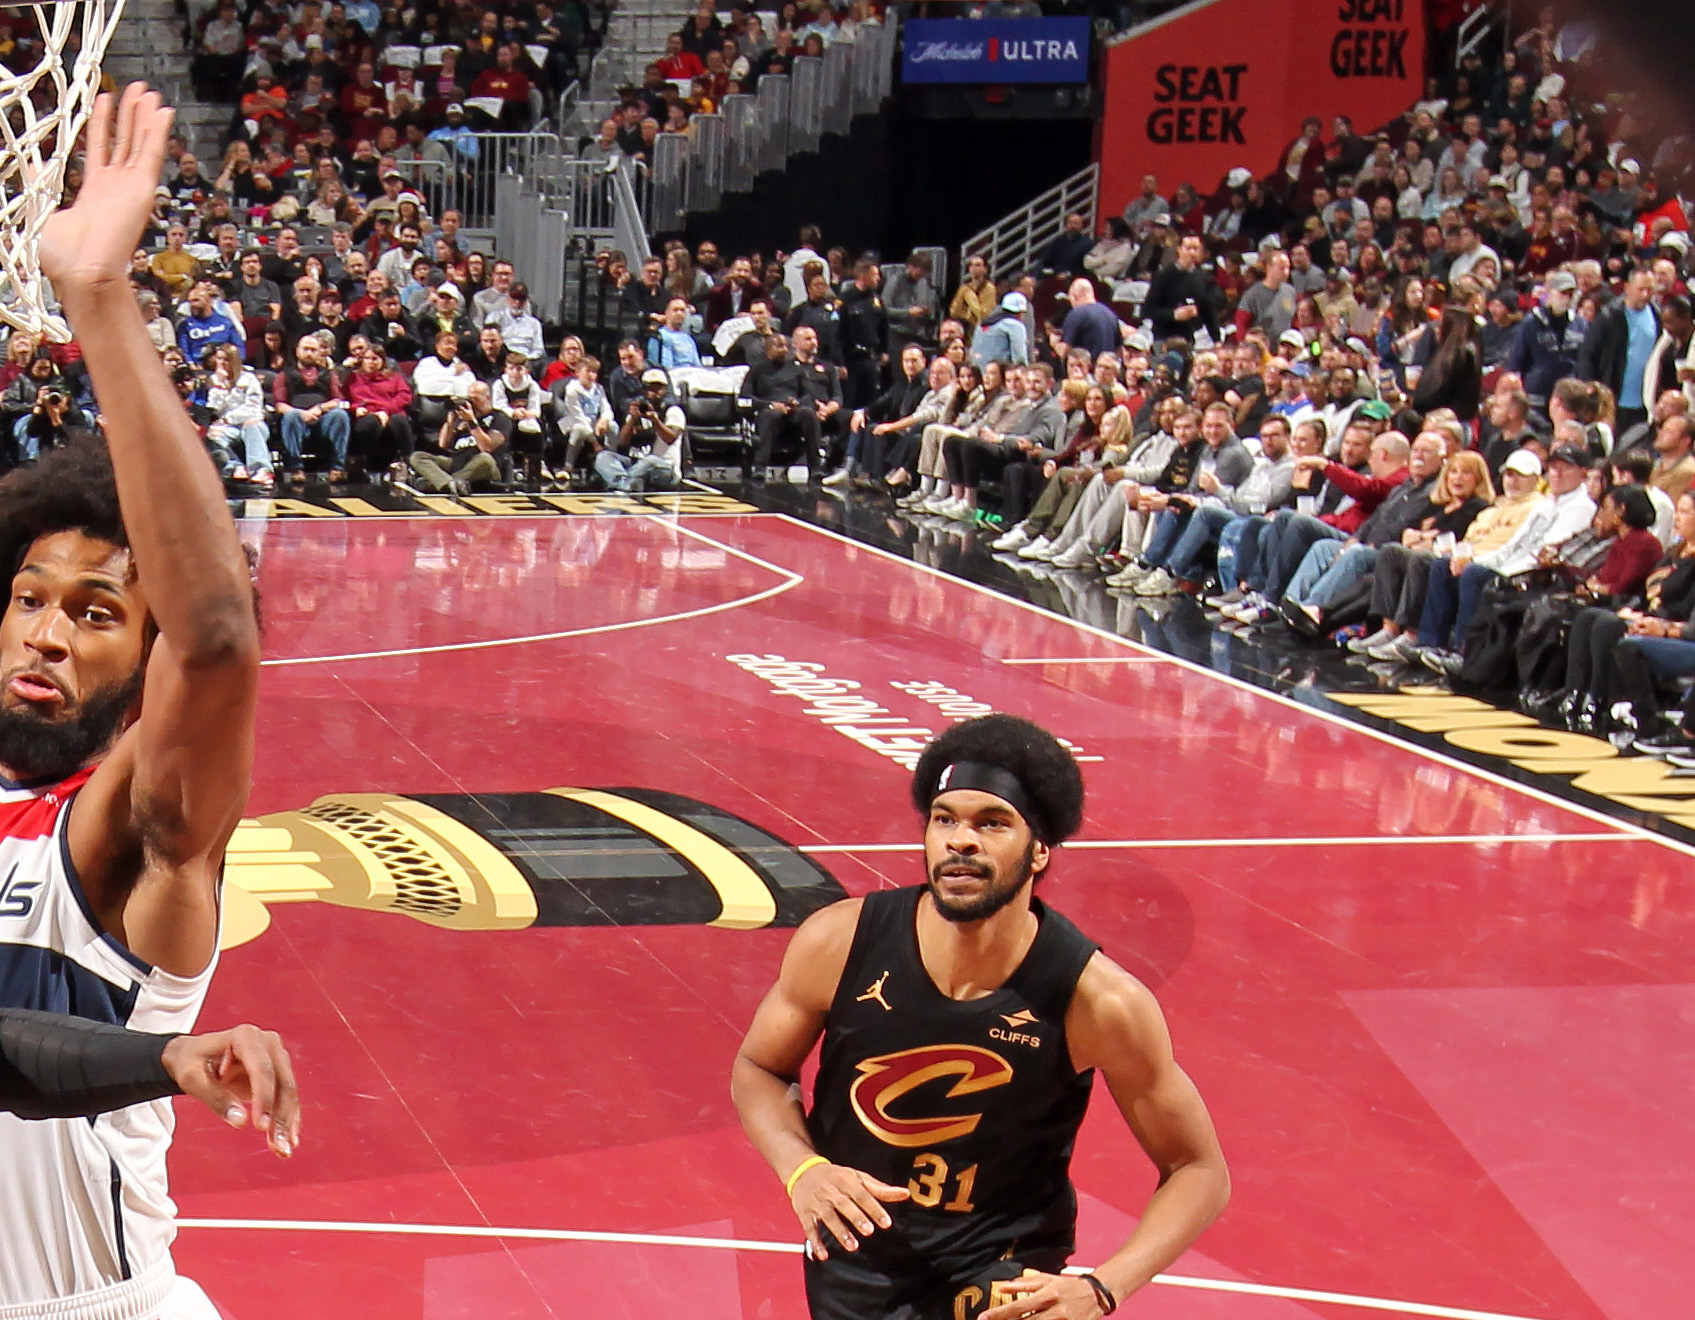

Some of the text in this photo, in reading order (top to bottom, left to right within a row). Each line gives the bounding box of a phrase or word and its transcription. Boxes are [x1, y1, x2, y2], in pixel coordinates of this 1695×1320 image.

[1004, 40, 1078, 61] ULTRA
[1330, 29, 1408, 80] GEEK
[1154, 64, 1248, 102] SEAT
[1146, 106, 1247, 145] GEEK
[988, 1027, 1041, 1049] CLIFFS
[908, 1152, 980, 1213] 31
